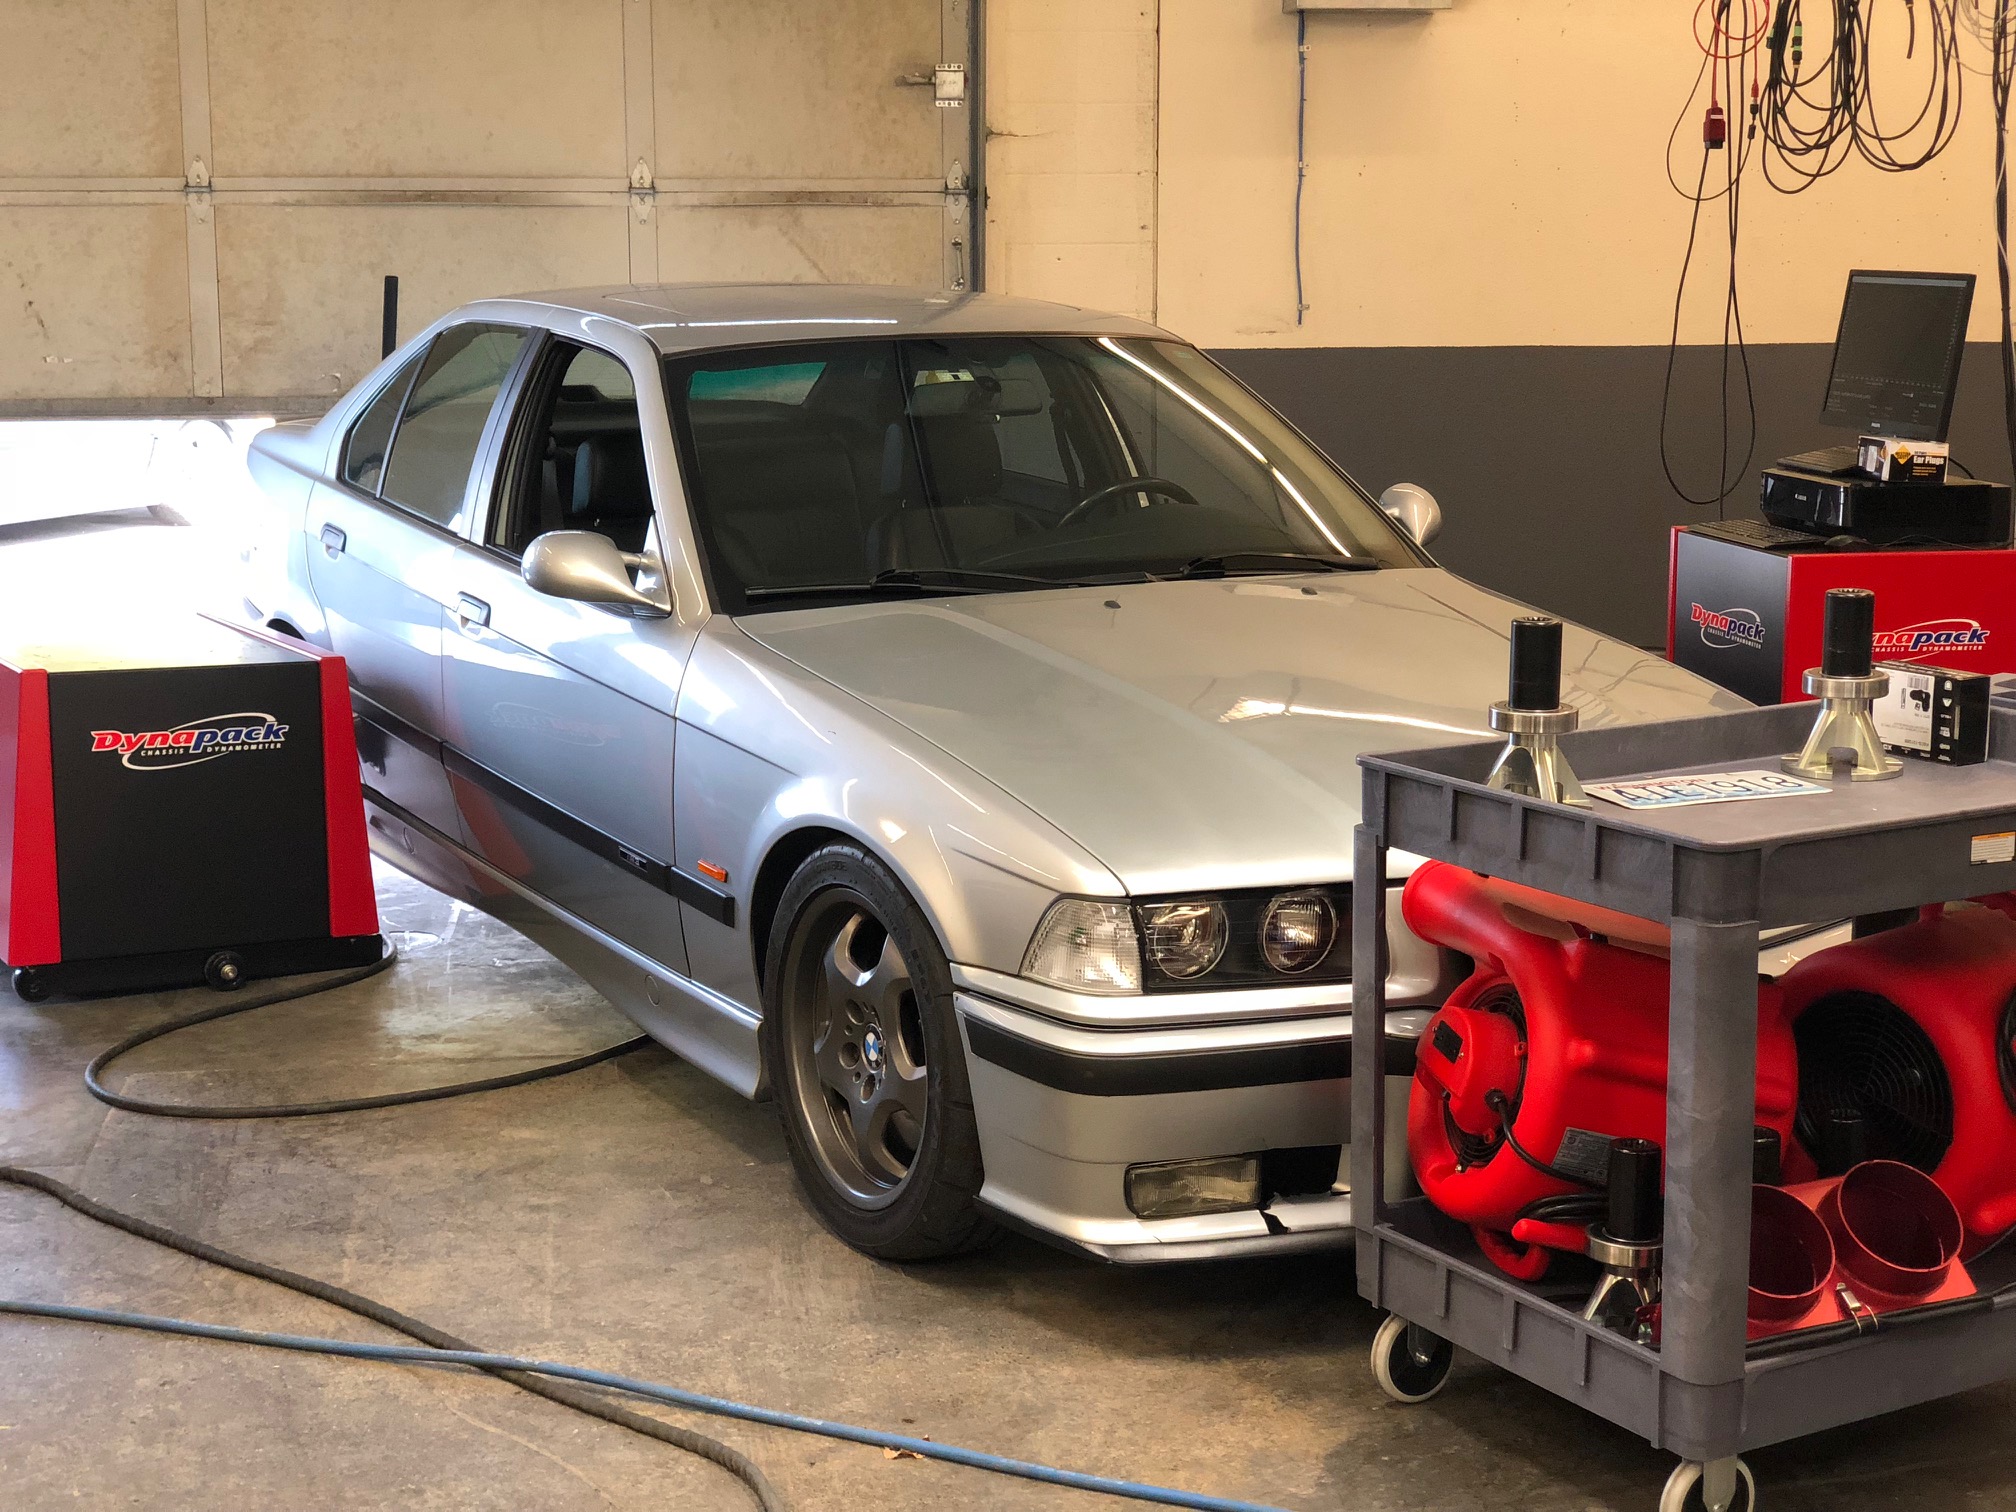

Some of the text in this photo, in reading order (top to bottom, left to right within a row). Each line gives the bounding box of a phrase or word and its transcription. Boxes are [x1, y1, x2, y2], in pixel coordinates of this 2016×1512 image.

[1913, 456, 1944, 466] Ear Plugs
[1691, 602, 1765, 642] Dynapack
[1872, 627, 1990, 652] napack
[91, 722, 290, 755] Dynapack
[141, 743, 282, 756] CHASSIS DYNAMOMETER
